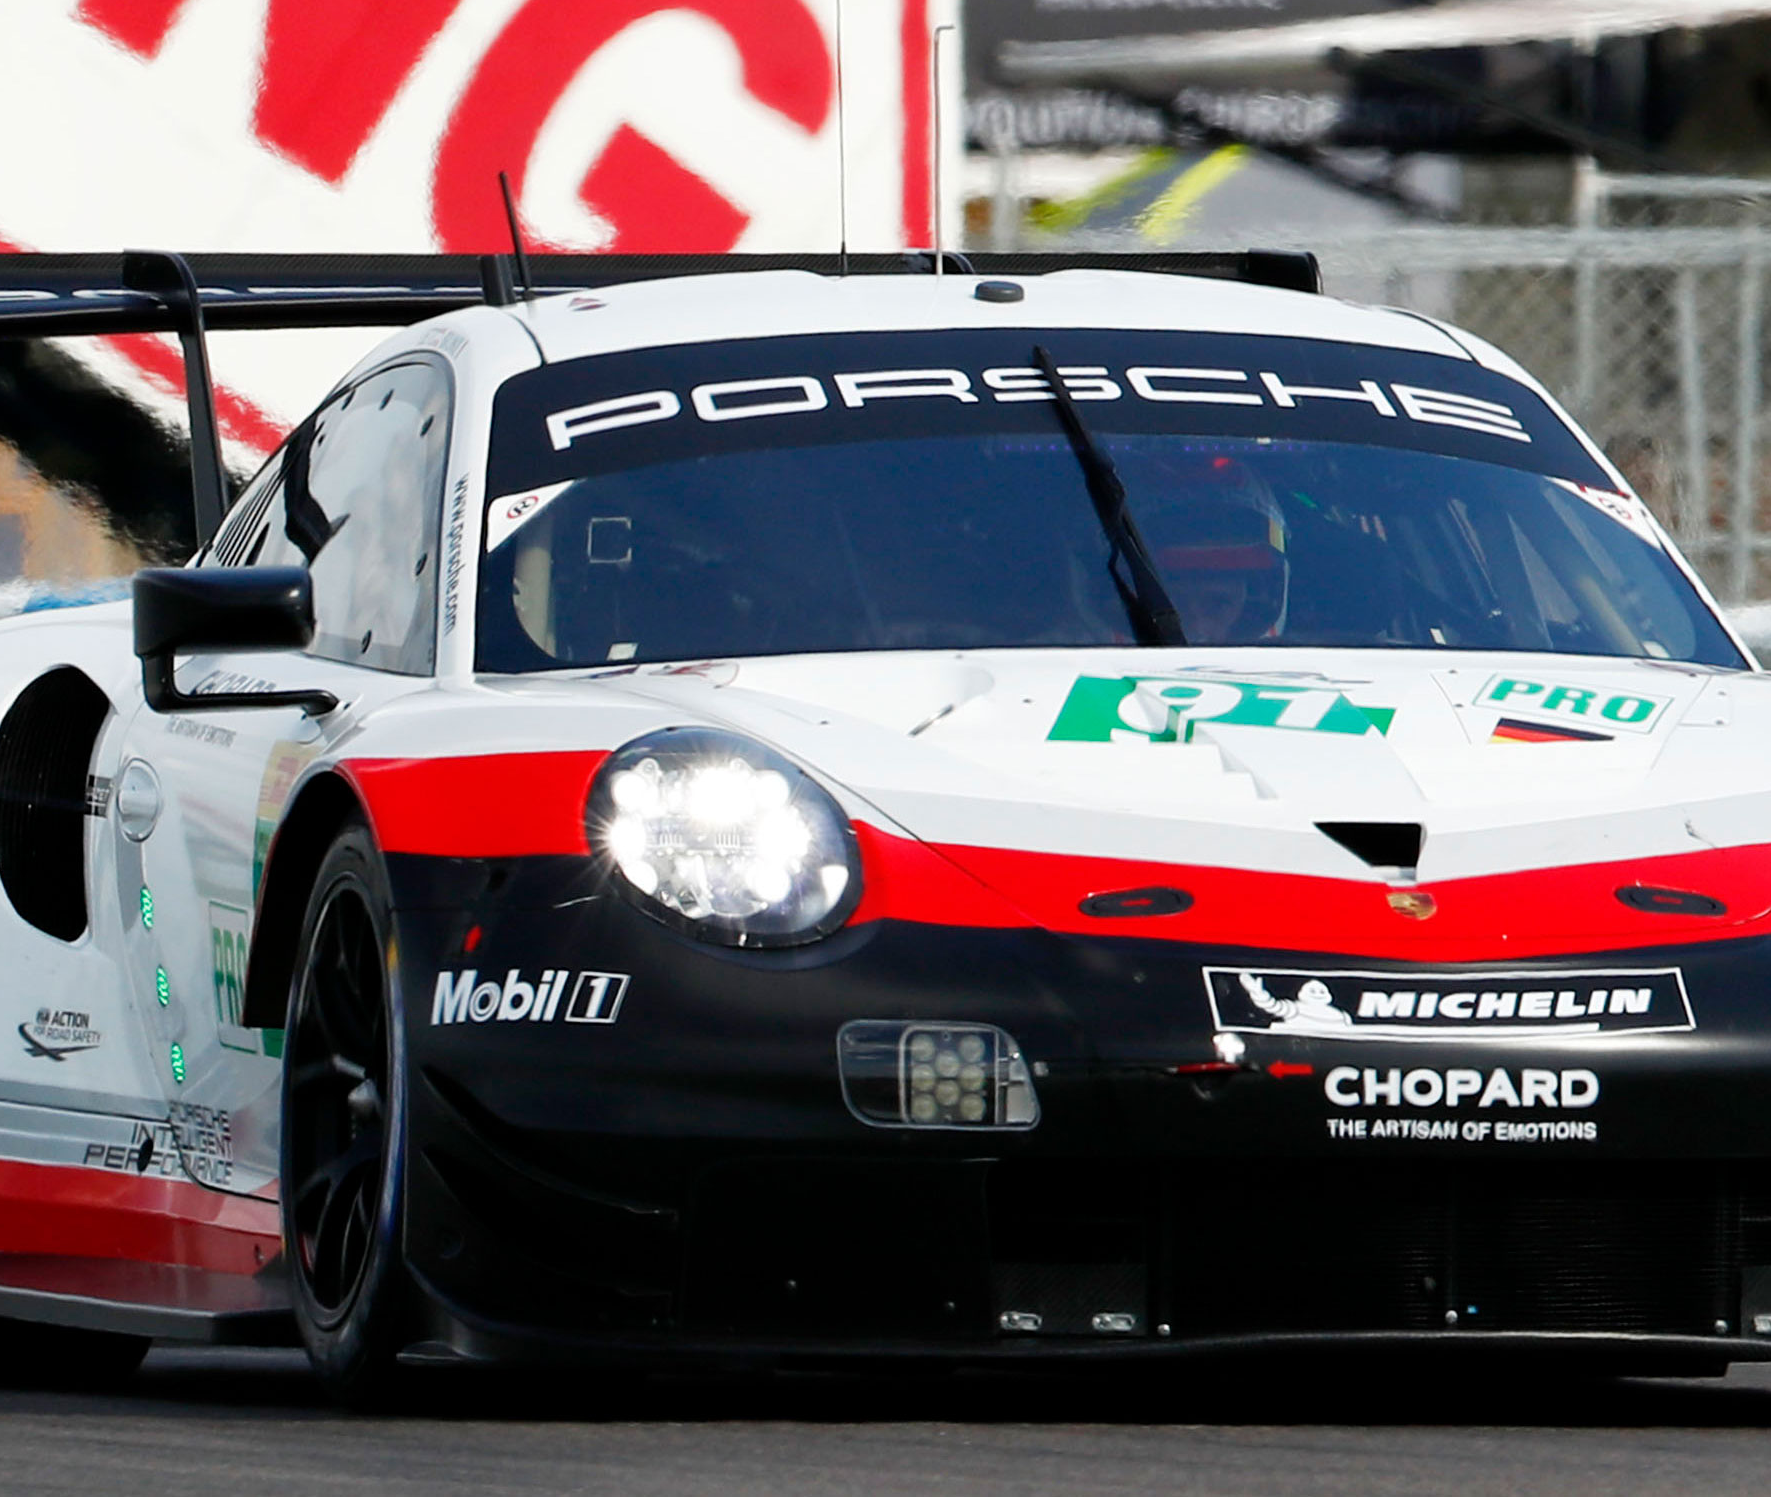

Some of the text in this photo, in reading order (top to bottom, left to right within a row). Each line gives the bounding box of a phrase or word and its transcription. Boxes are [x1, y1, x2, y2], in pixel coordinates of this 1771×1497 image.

[546, 366, 1532, 451] PORSCHE
[442, 471, 471, 638] www.porsche.com
[1111, 679, 1338, 744] 91
[1490, 678, 1659, 724] PRO
[431, 968, 569, 1026] Mobil
[1357, 987, 1652, 1020] MICHELIN
[46, 1027, 71, 1041] ROAD
[72, 1030, 102, 1043] SAFETY
[51, 1011, 90, 1028] ACTION
[1324, 1066, 1600, 1108] CHOPARD
[1326, 1118, 1598, 1142] THE ARTISAN OF EMOTIONS
